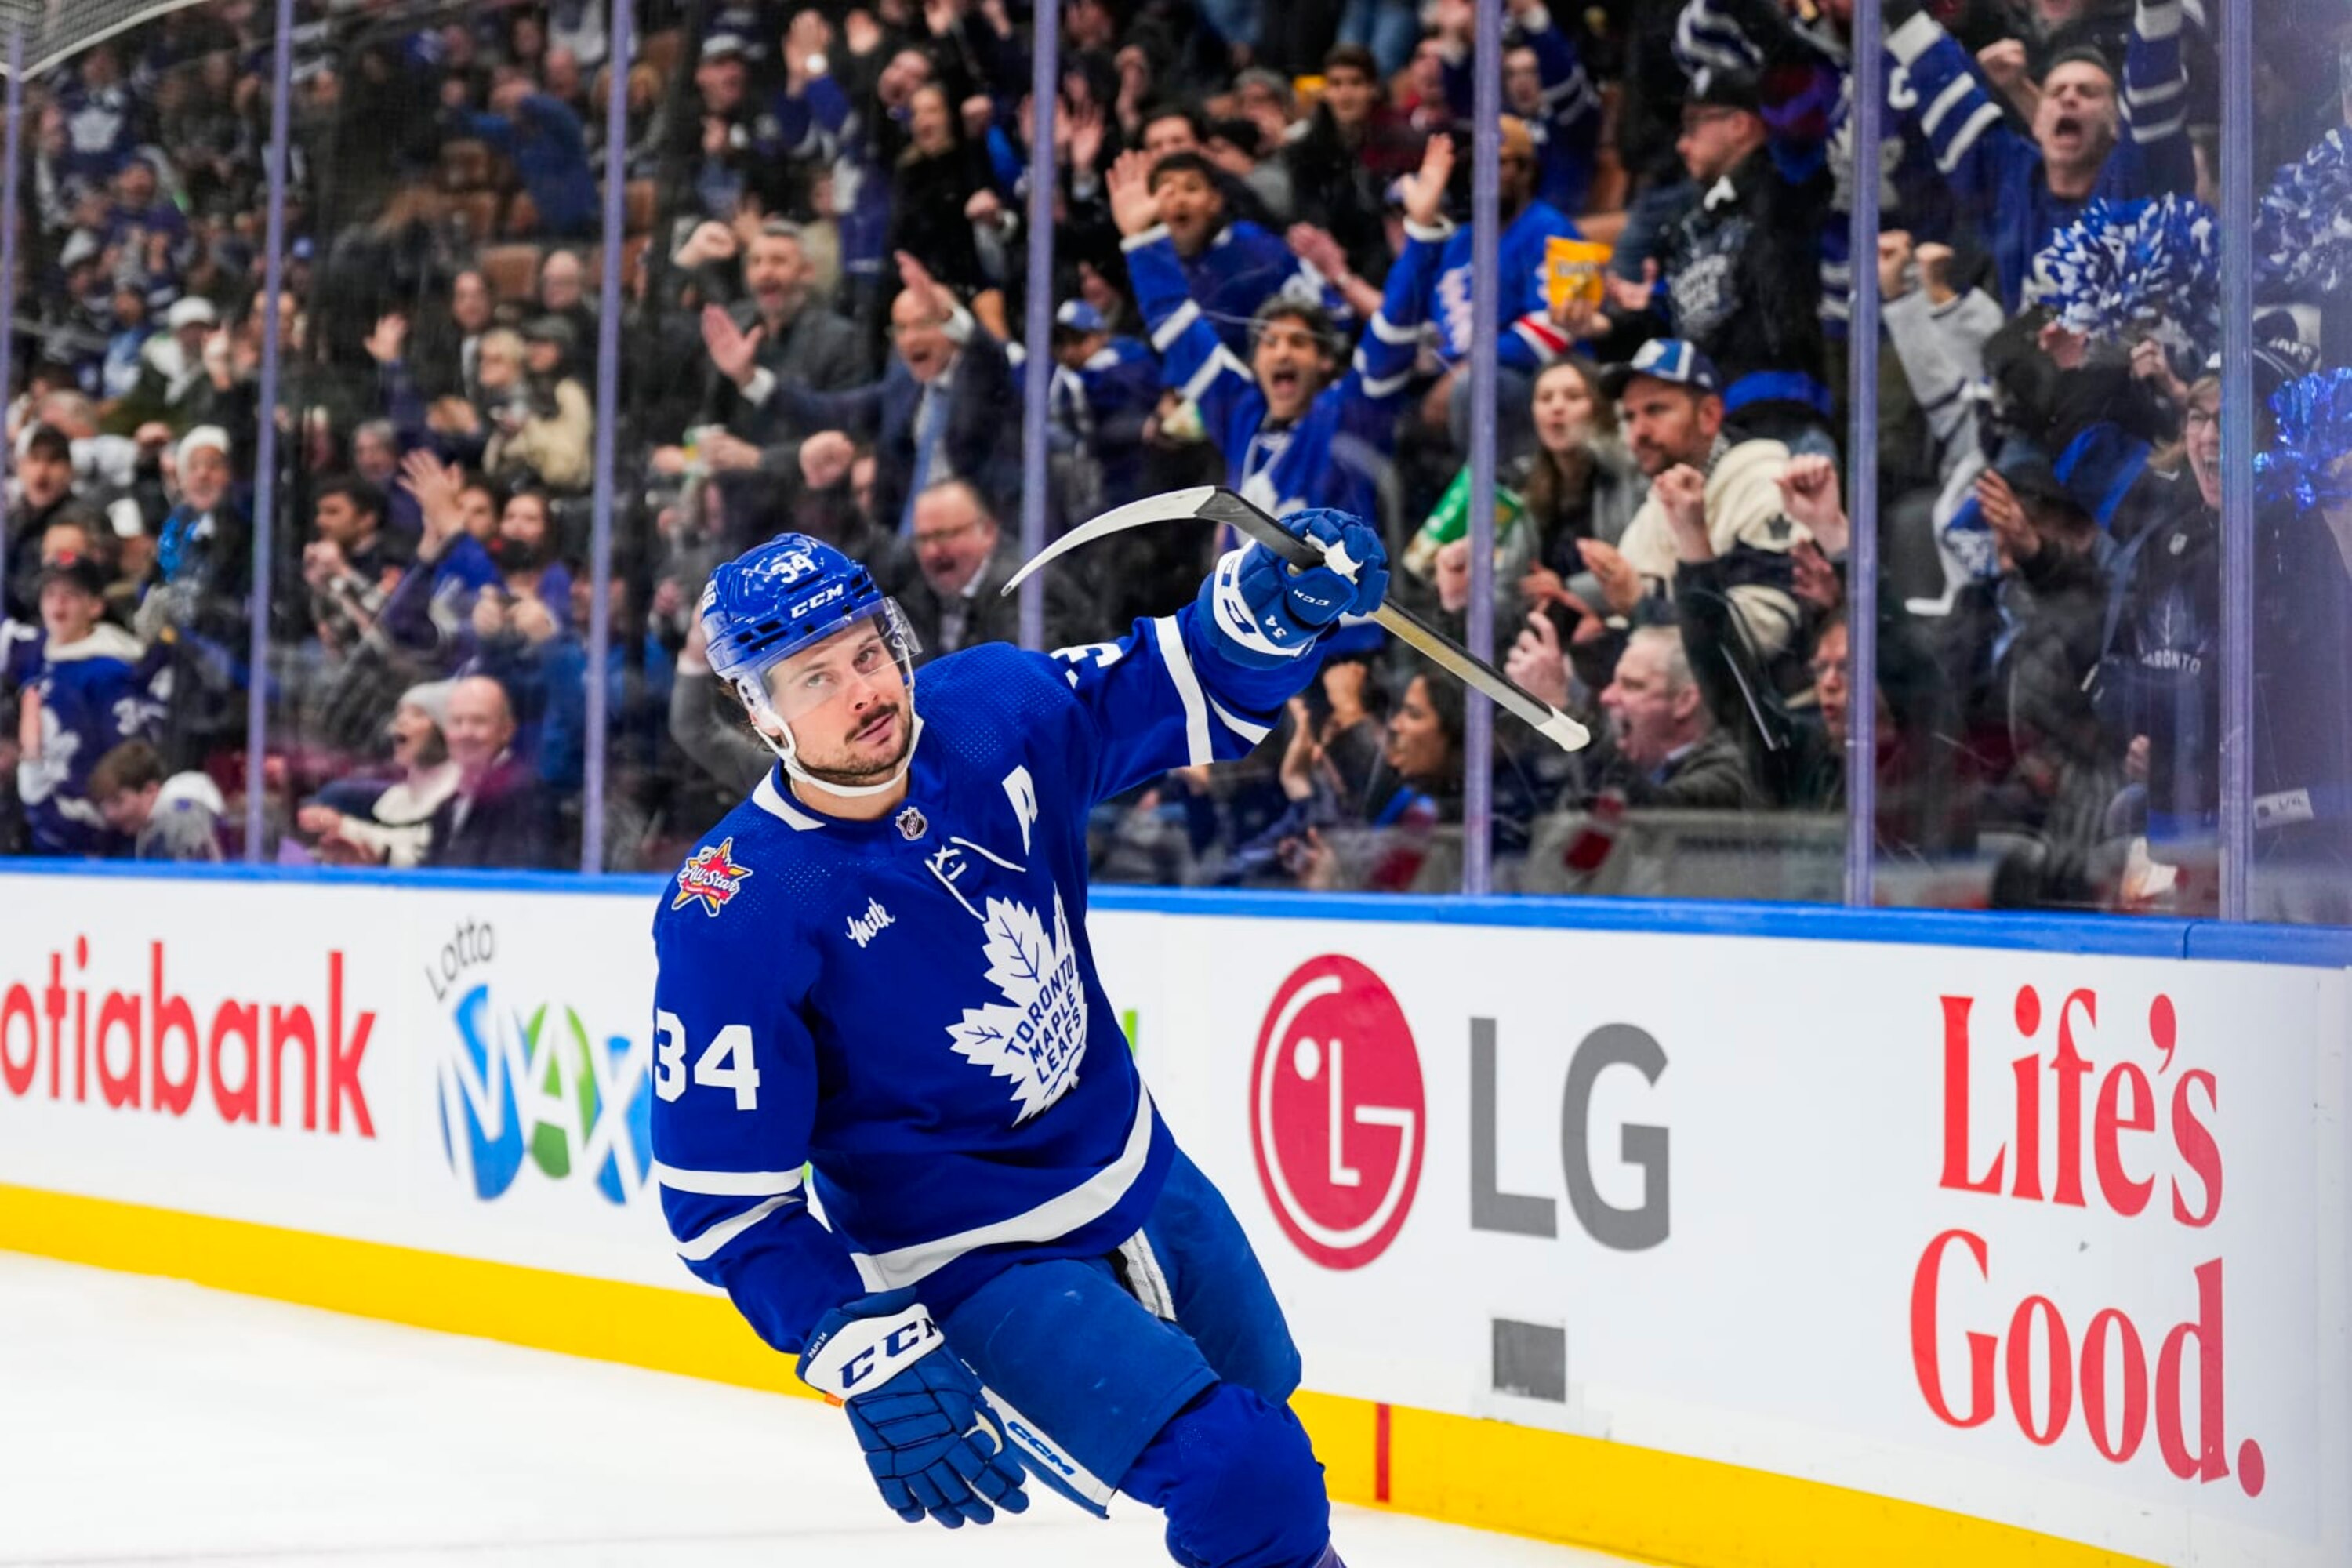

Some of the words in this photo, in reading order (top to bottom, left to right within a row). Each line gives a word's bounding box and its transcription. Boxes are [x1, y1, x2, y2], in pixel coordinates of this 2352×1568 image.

[771, 551, 816, 584] 34
[790, 584, 844, 619] CCM
[1293, 589, 1330, 607] CCM
[426, 918, 494, 1002] Lotto
[1004, 954, 1074, 1056] TORONTO
[1029, 985, 1076, 1064] MAPLE
[1036, 1007, 1081, 1085] LEAFS
[437, 983, 654, 1205] MAX
[655, 1007, 760, 1111] 34
[1469, 1016, 1671, 1253] LG
[1939, 985, 2223, 1228] Life's
[1910, 1229, 2266, 1497] Good.
[1007, 1421, 1076, 1477] CCM
